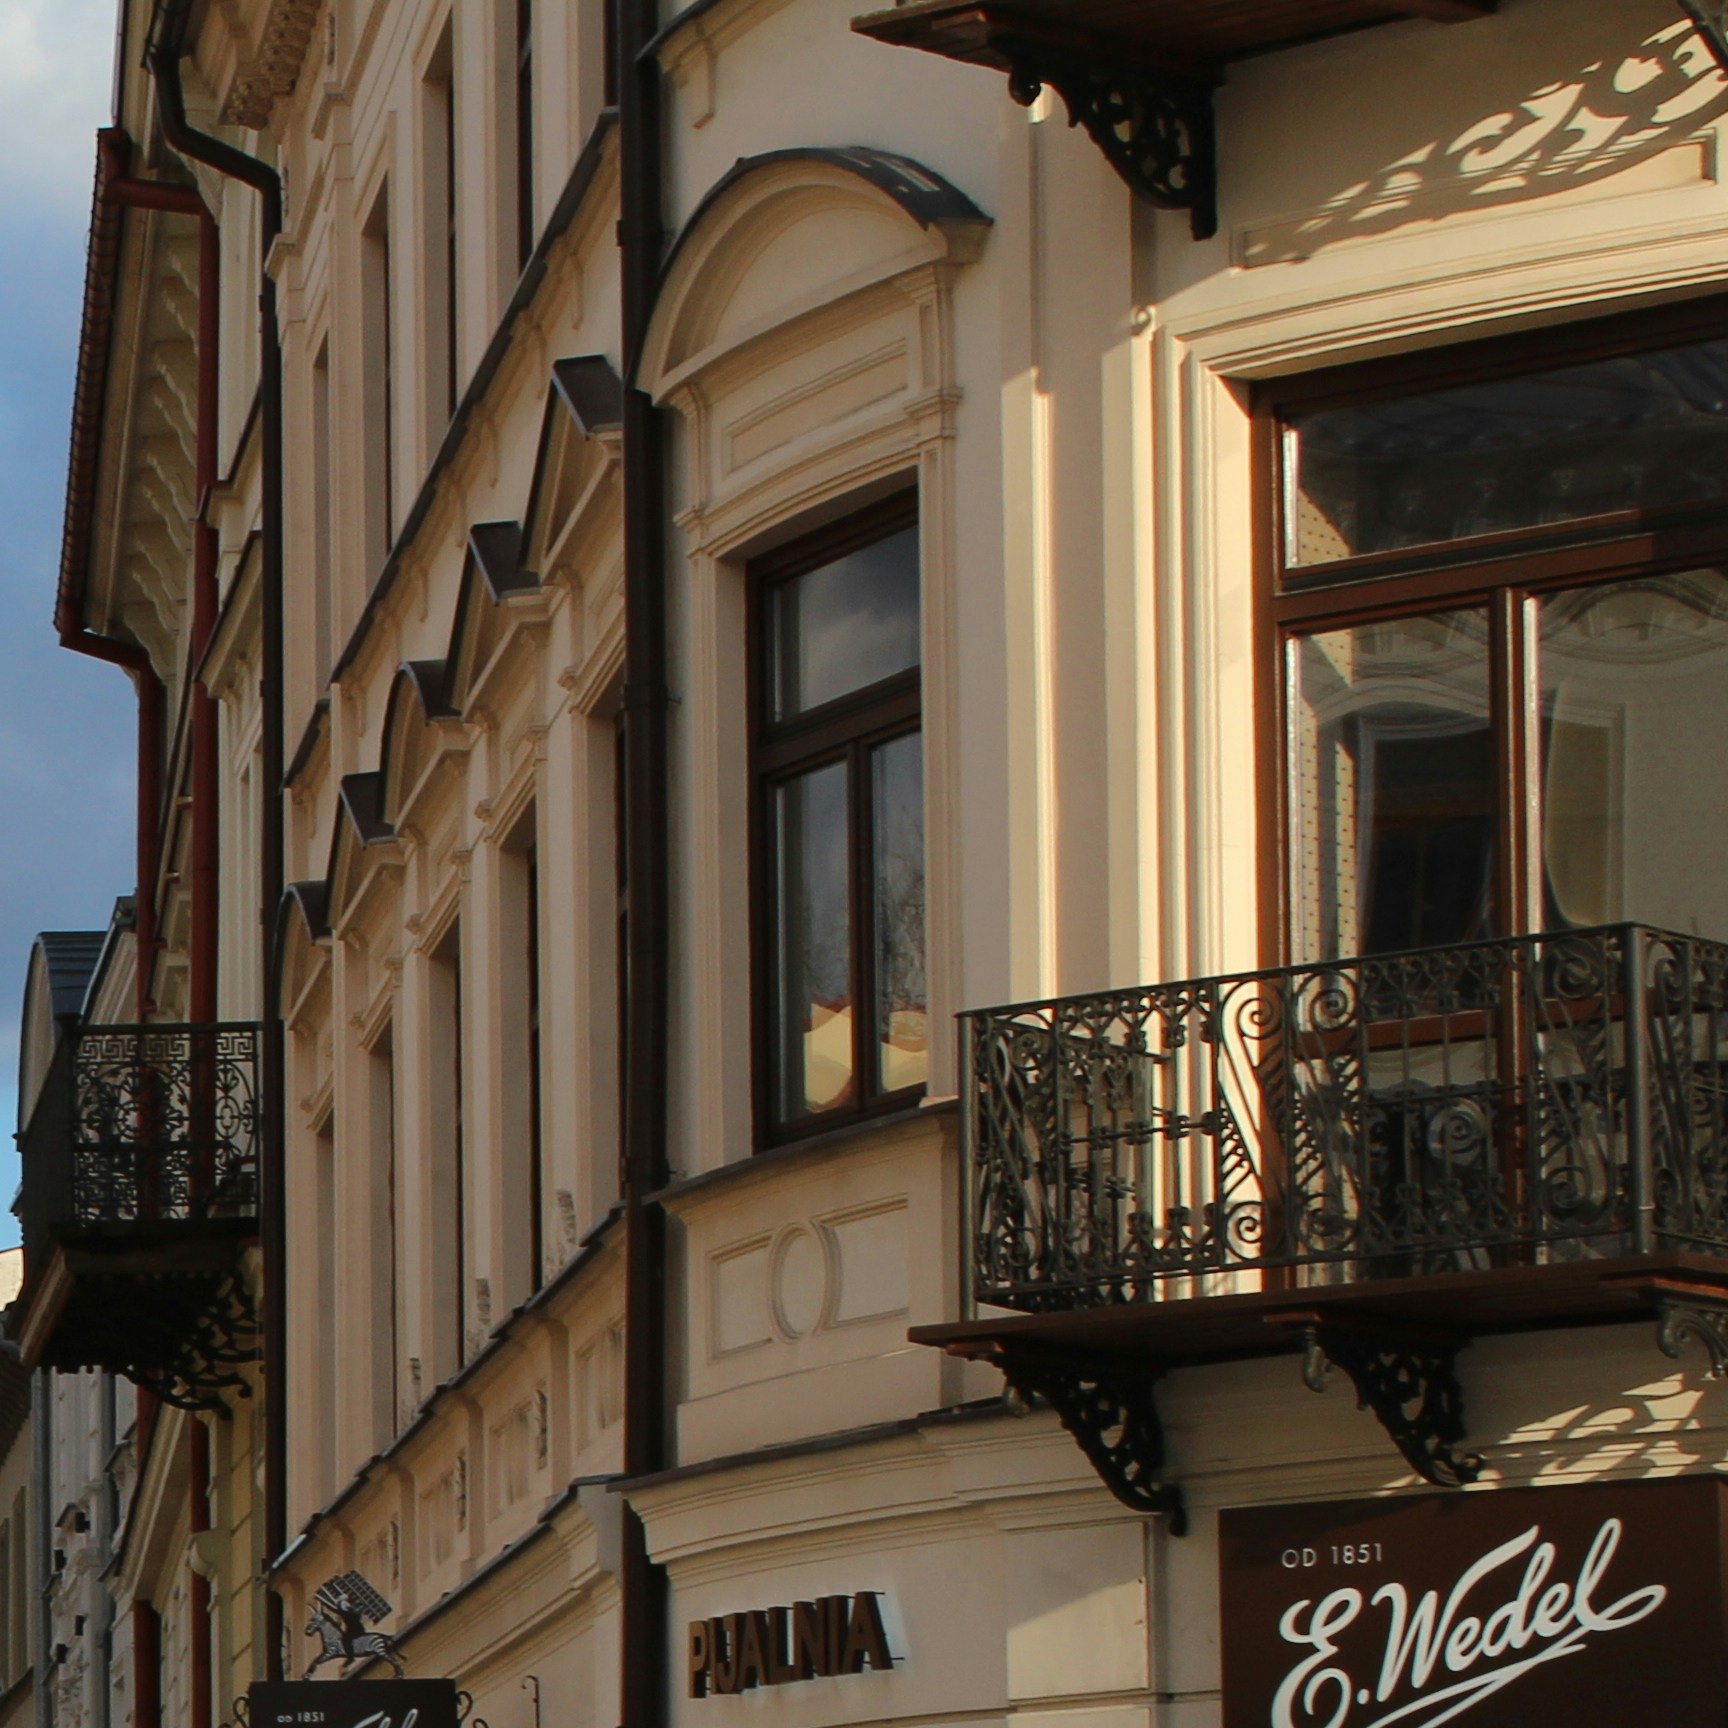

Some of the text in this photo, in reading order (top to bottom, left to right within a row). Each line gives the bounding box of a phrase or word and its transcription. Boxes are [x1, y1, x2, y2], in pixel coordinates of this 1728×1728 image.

[1281, 1543, 1382, 1568] OD 1851
[688, 1590, 894, 1699] PIJALNIA
[298, 1712, 325, 1723] 1851
